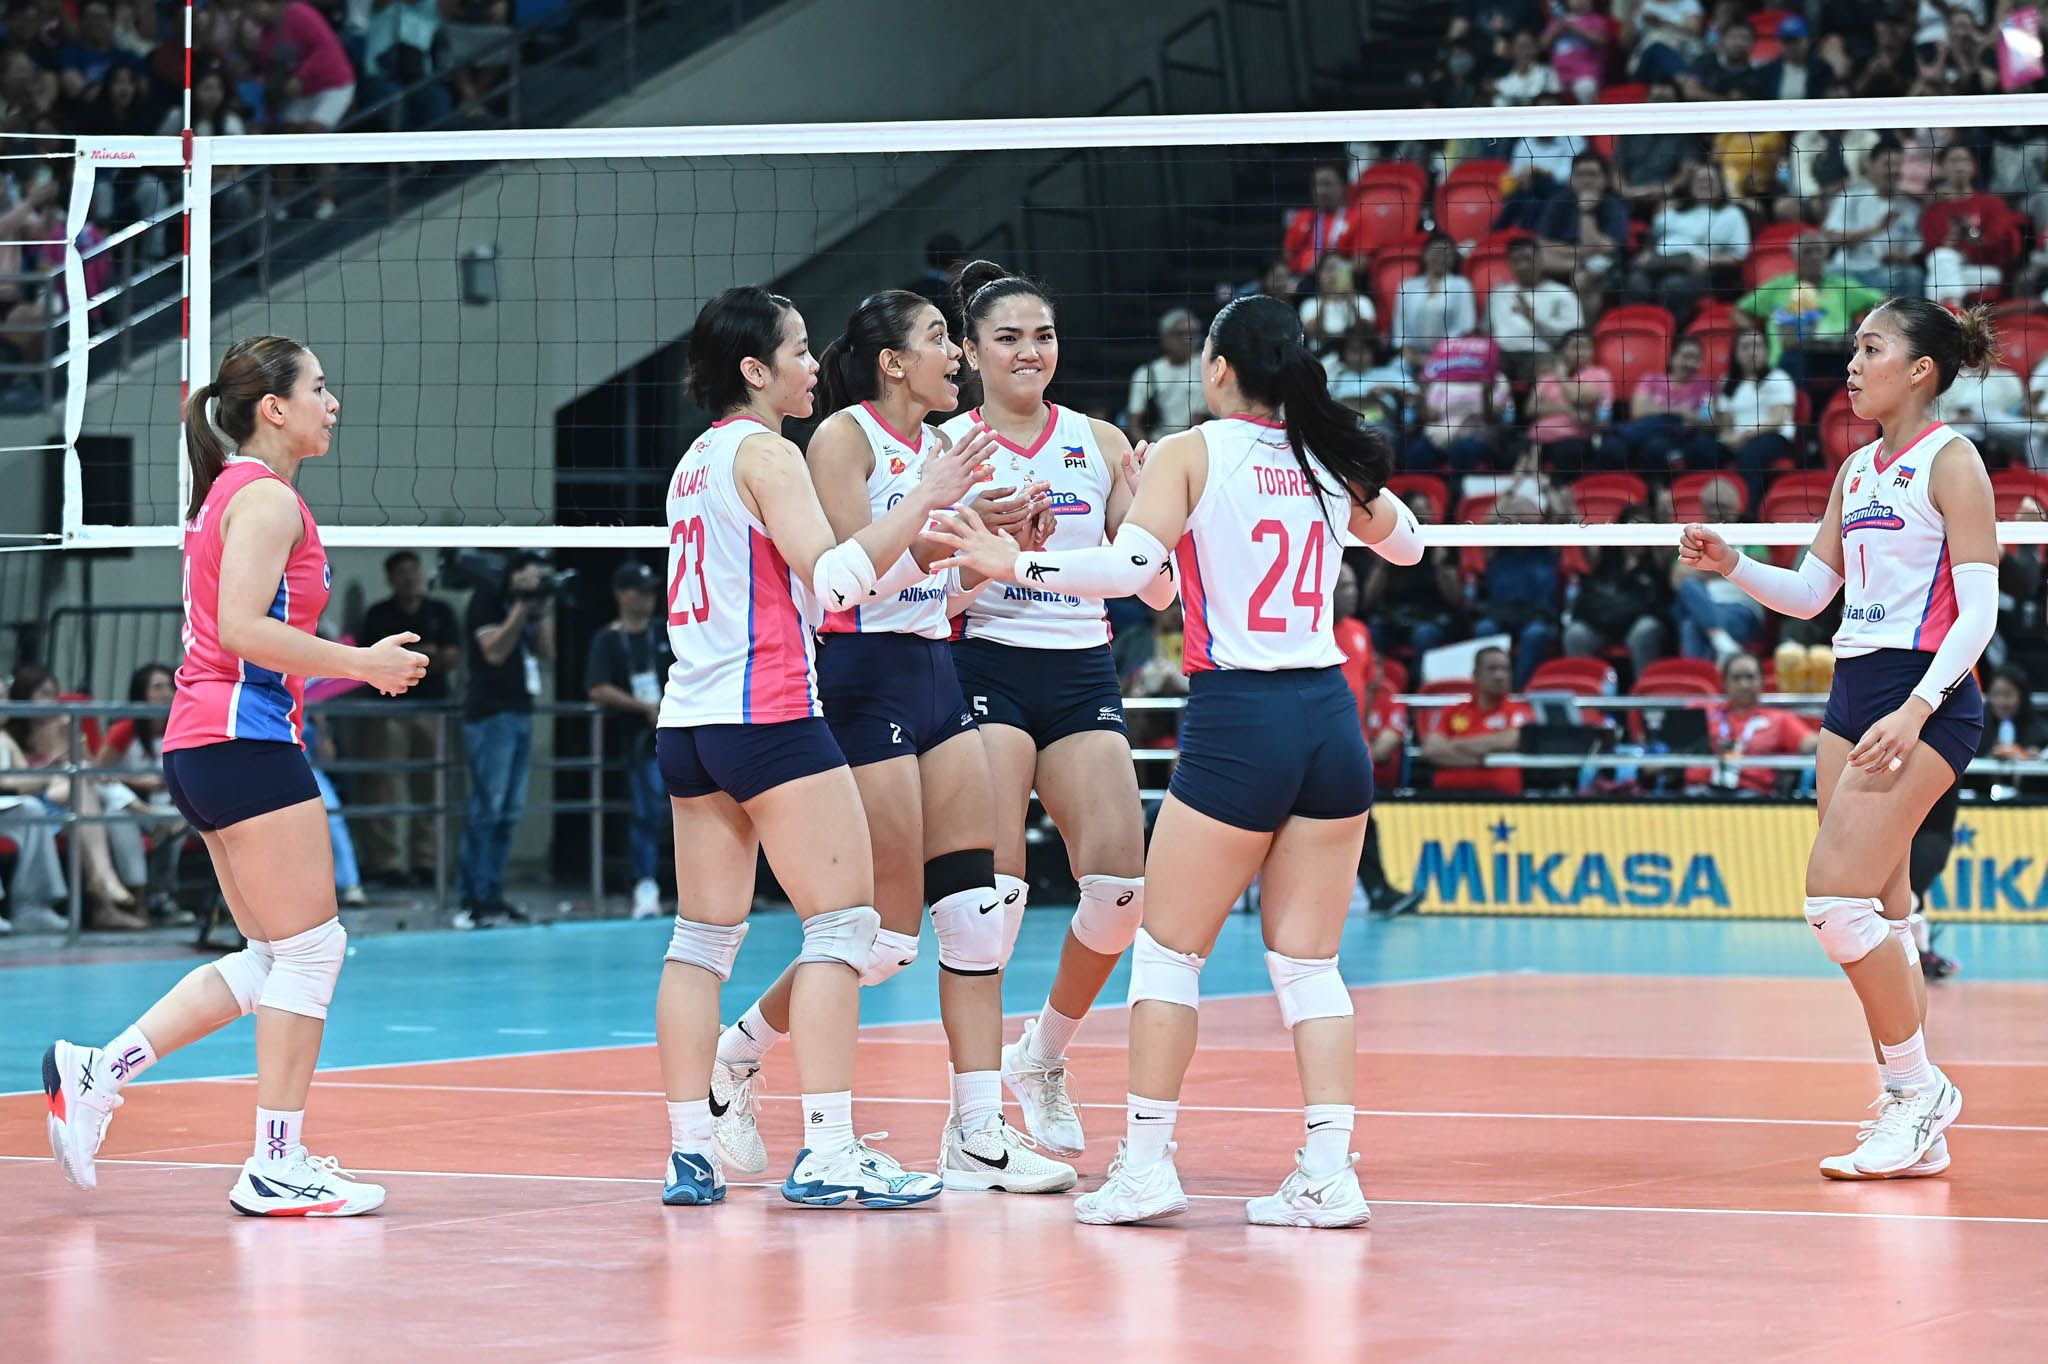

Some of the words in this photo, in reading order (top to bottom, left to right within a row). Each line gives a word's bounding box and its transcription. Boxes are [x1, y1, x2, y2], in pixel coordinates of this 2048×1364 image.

[1064, 458, 1087, 469] PHI
[668, 514, 710, 627] 23
[1247, 519, 1325, 633] 24
[1003, 586, 1062, 602] Allianz
[973, 695, 989, 716] 5
[889, 722, 902, 744] 2
